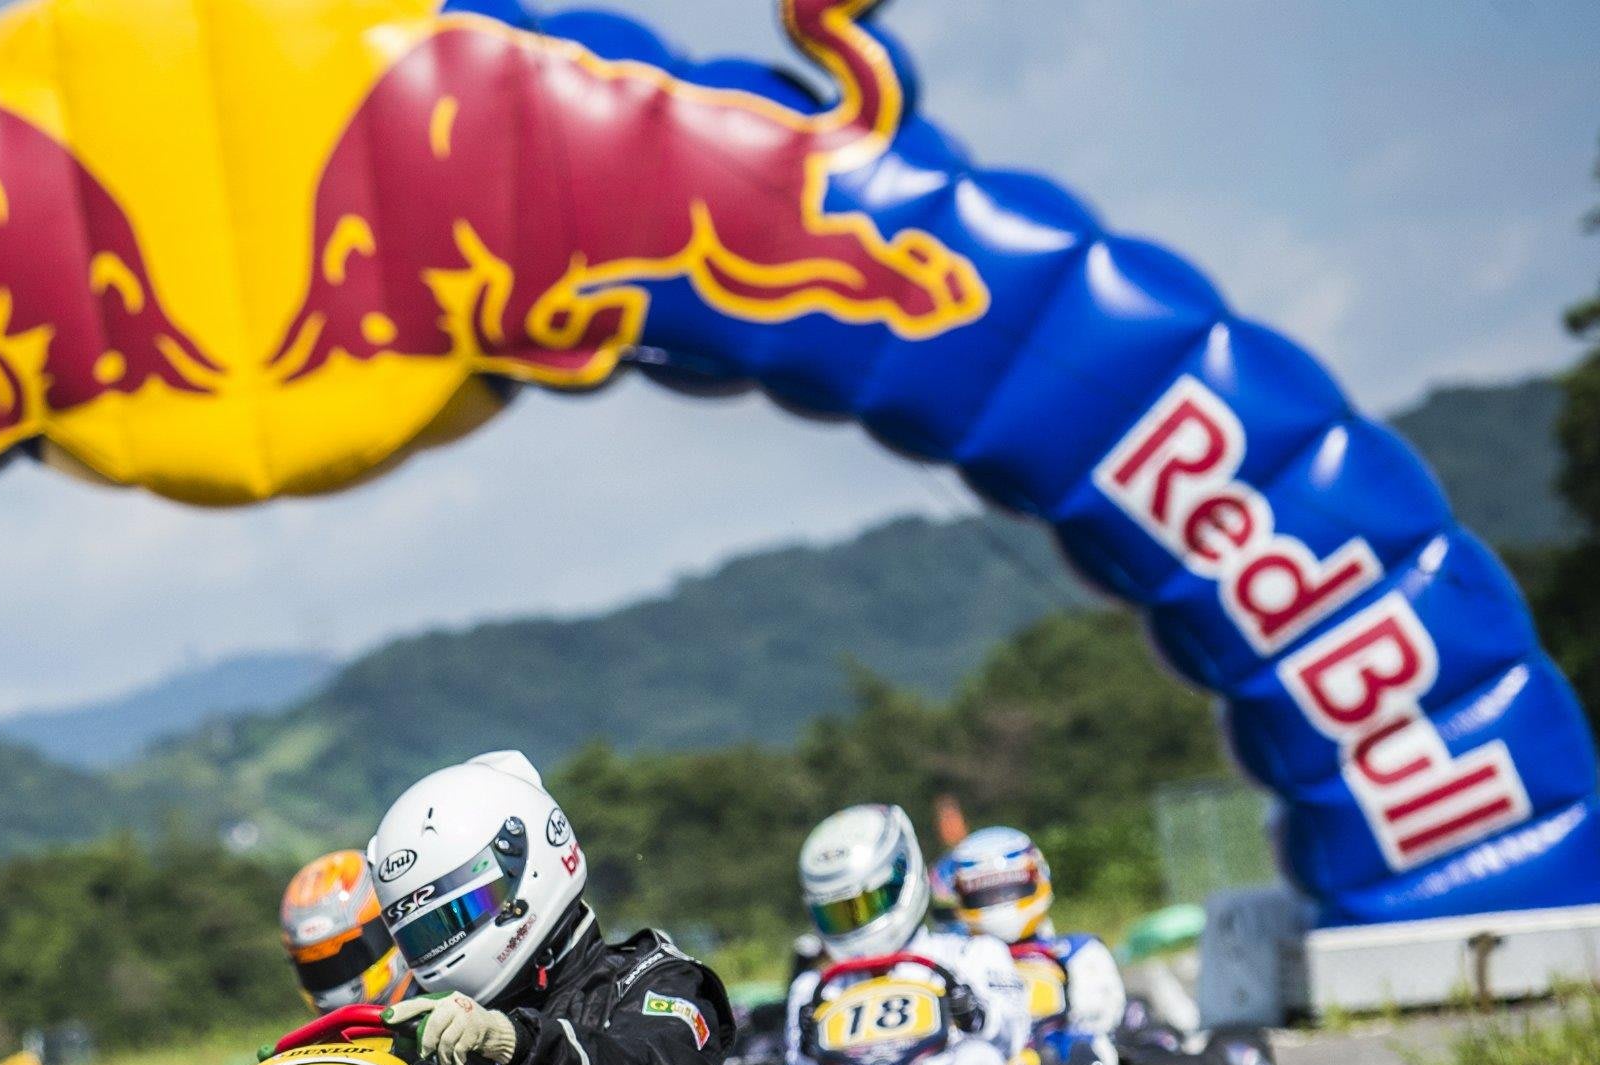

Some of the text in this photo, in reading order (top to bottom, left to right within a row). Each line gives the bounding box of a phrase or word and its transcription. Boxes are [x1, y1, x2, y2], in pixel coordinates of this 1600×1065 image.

[1111, 396, 1514, 857] Red Bull
[383, 851, 412, 874] Arai
[846, 997, 912, 1036] 18
[286, 1047, 375, 1057] DUNLOP
